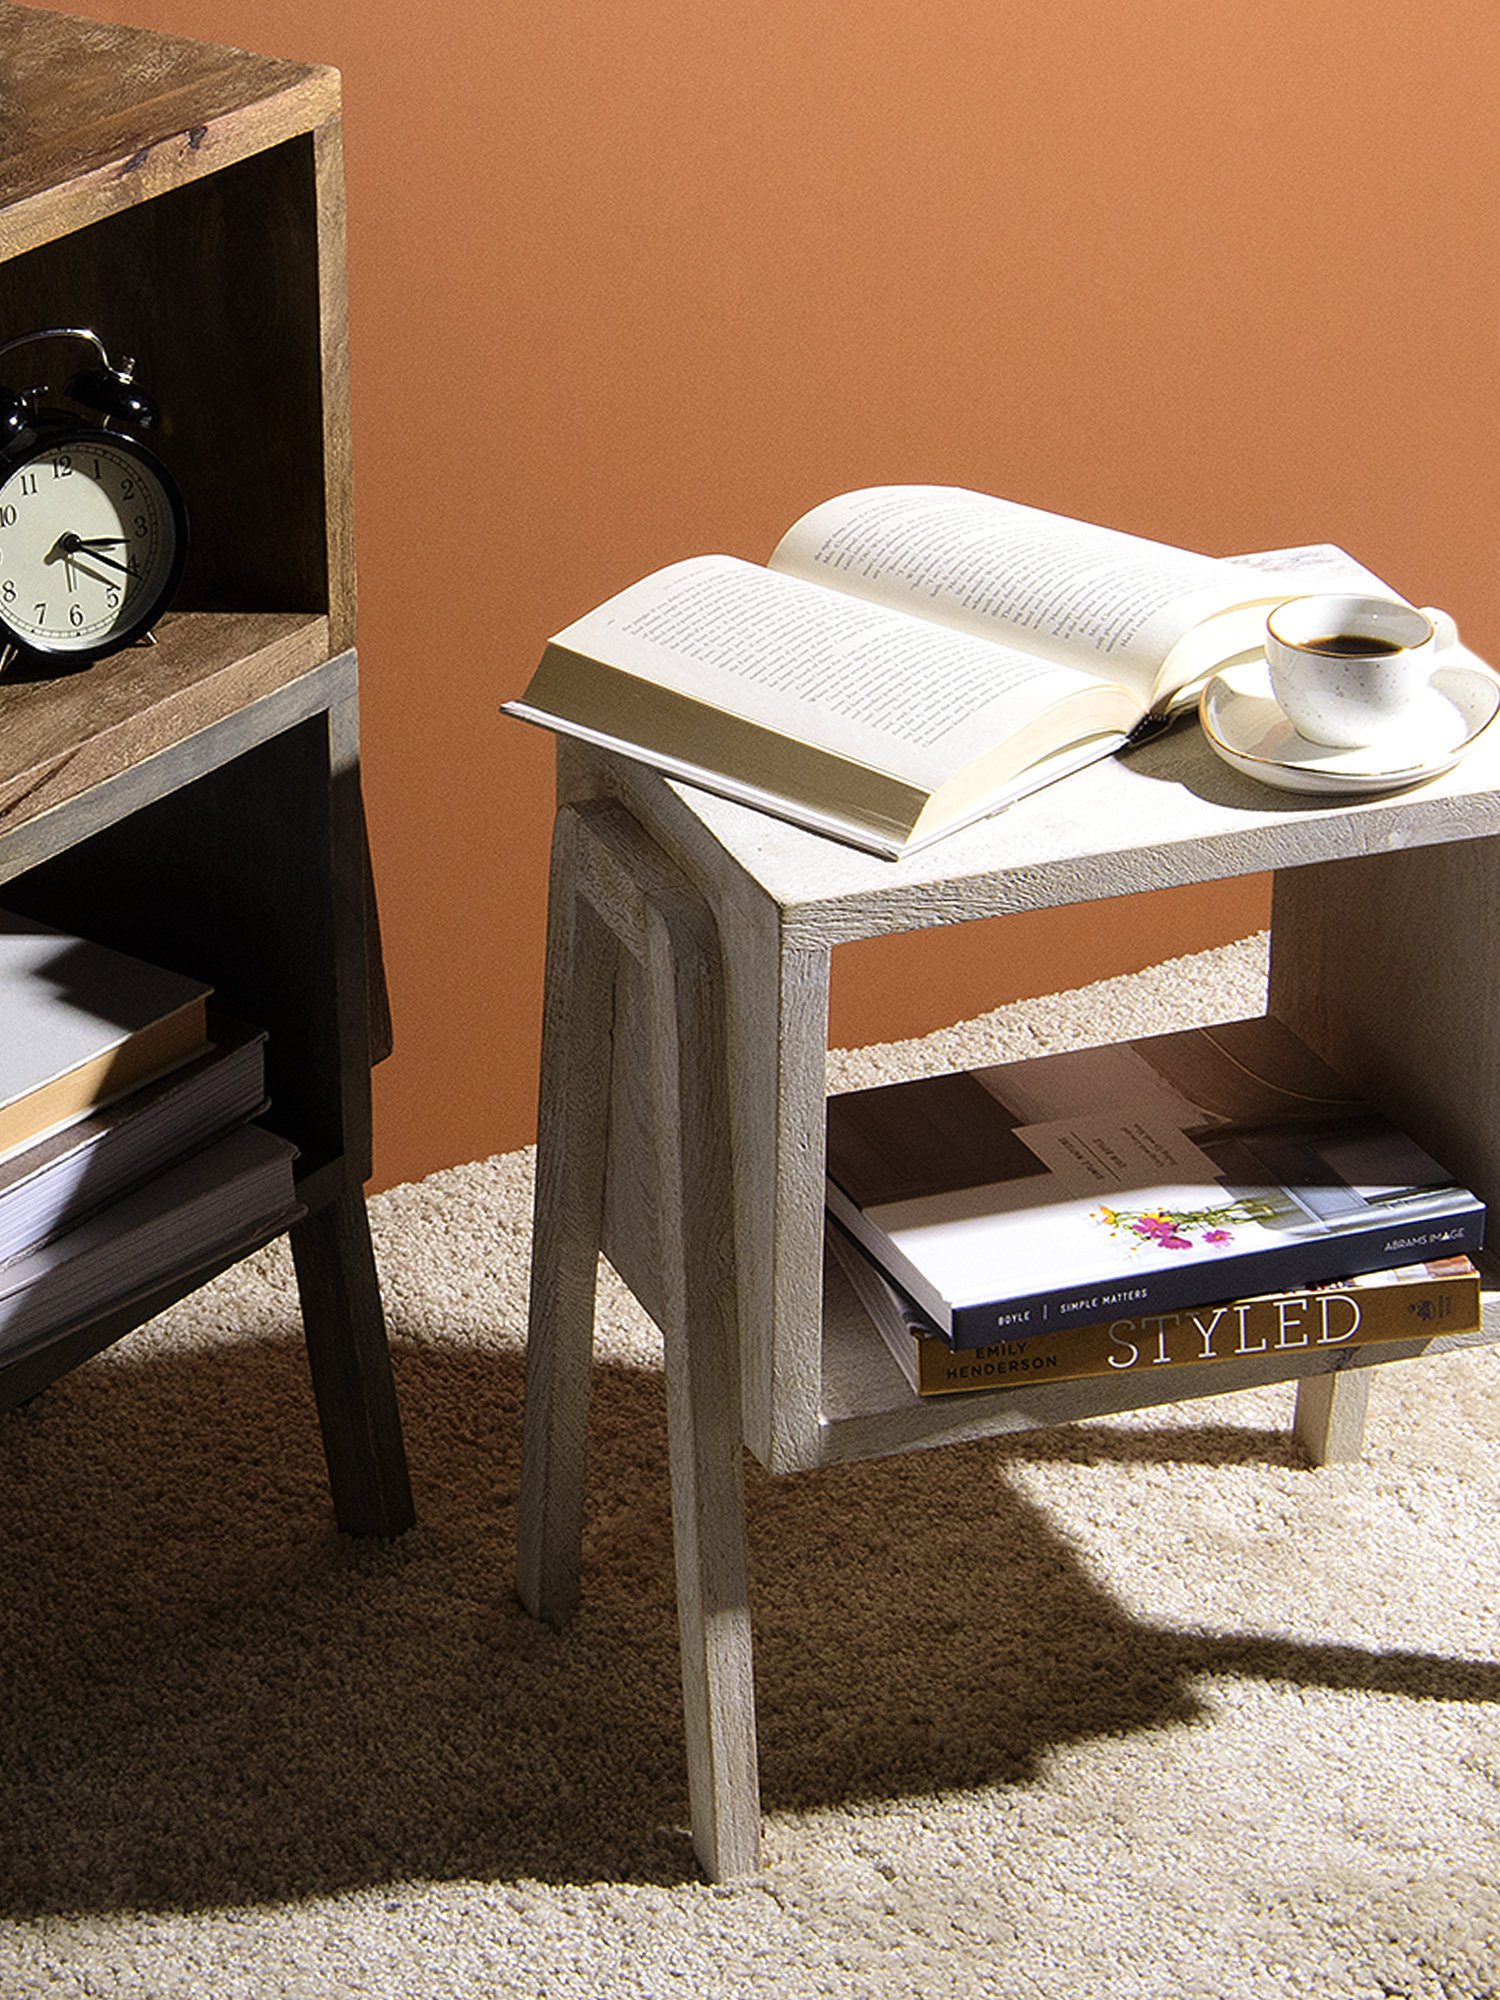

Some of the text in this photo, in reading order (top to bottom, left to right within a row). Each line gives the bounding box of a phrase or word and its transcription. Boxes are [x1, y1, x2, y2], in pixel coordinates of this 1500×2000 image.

[53, 455, 73, 479] 12
[93, 459, 102, 480] 1
[20, 472, 38, 496] 11
[120, 478, 135, 500] 2
[0, 504, 17, 528] 10
[134, 516, 149, 538] 3
[127, 553, 140, 573] 4
[2, 579, 17, 602] 8
[105, 584, 119, 609] 5
[34, 603, 46, 625] 7
[69, 603, 84, 627] 6
[1384, 1227, 1465, 1252] ABRAMS IMAGE
[998, 1287, 1149, 1327] BOYLE SIMPLE MATTERS
[1107, 1294, 1362, 1369] STYLED
[975, 1341, 1028, 1360] EMILY
[946, 1355, 1058, 1380] HENDERSON
